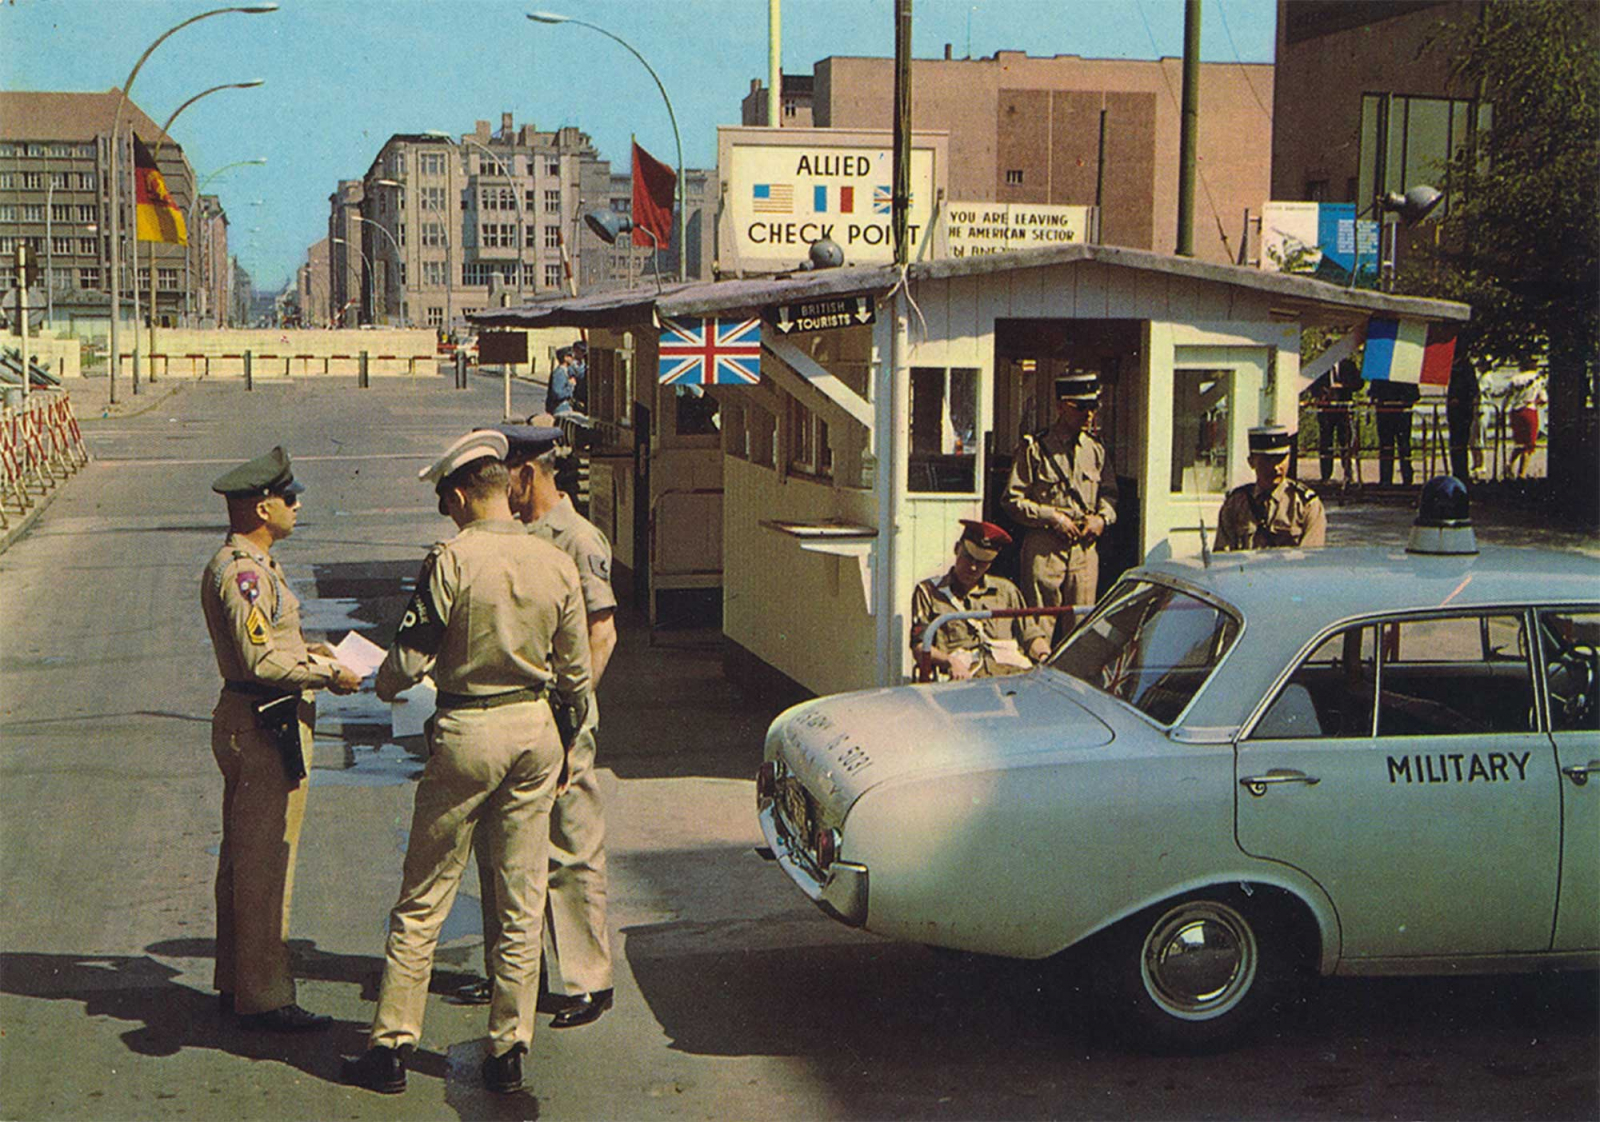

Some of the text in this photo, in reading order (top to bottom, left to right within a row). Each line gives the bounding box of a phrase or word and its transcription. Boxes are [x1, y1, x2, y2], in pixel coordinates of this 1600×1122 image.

[796, 155, 871, 176] ALLIED
[950, 210, 1068, 226] YOU ARE LEAVING
[748, 222, 920, 245] CHECK POIT
[948, 226, 1075, 242] HE AMERICAN SECTOR
[801, 302, 846, 317] BRITISH
[797, 313, 852, 331] TOURISTS
[399, 610, 417, 632] P
[1386, 751, 1532, 784] MILITARY
